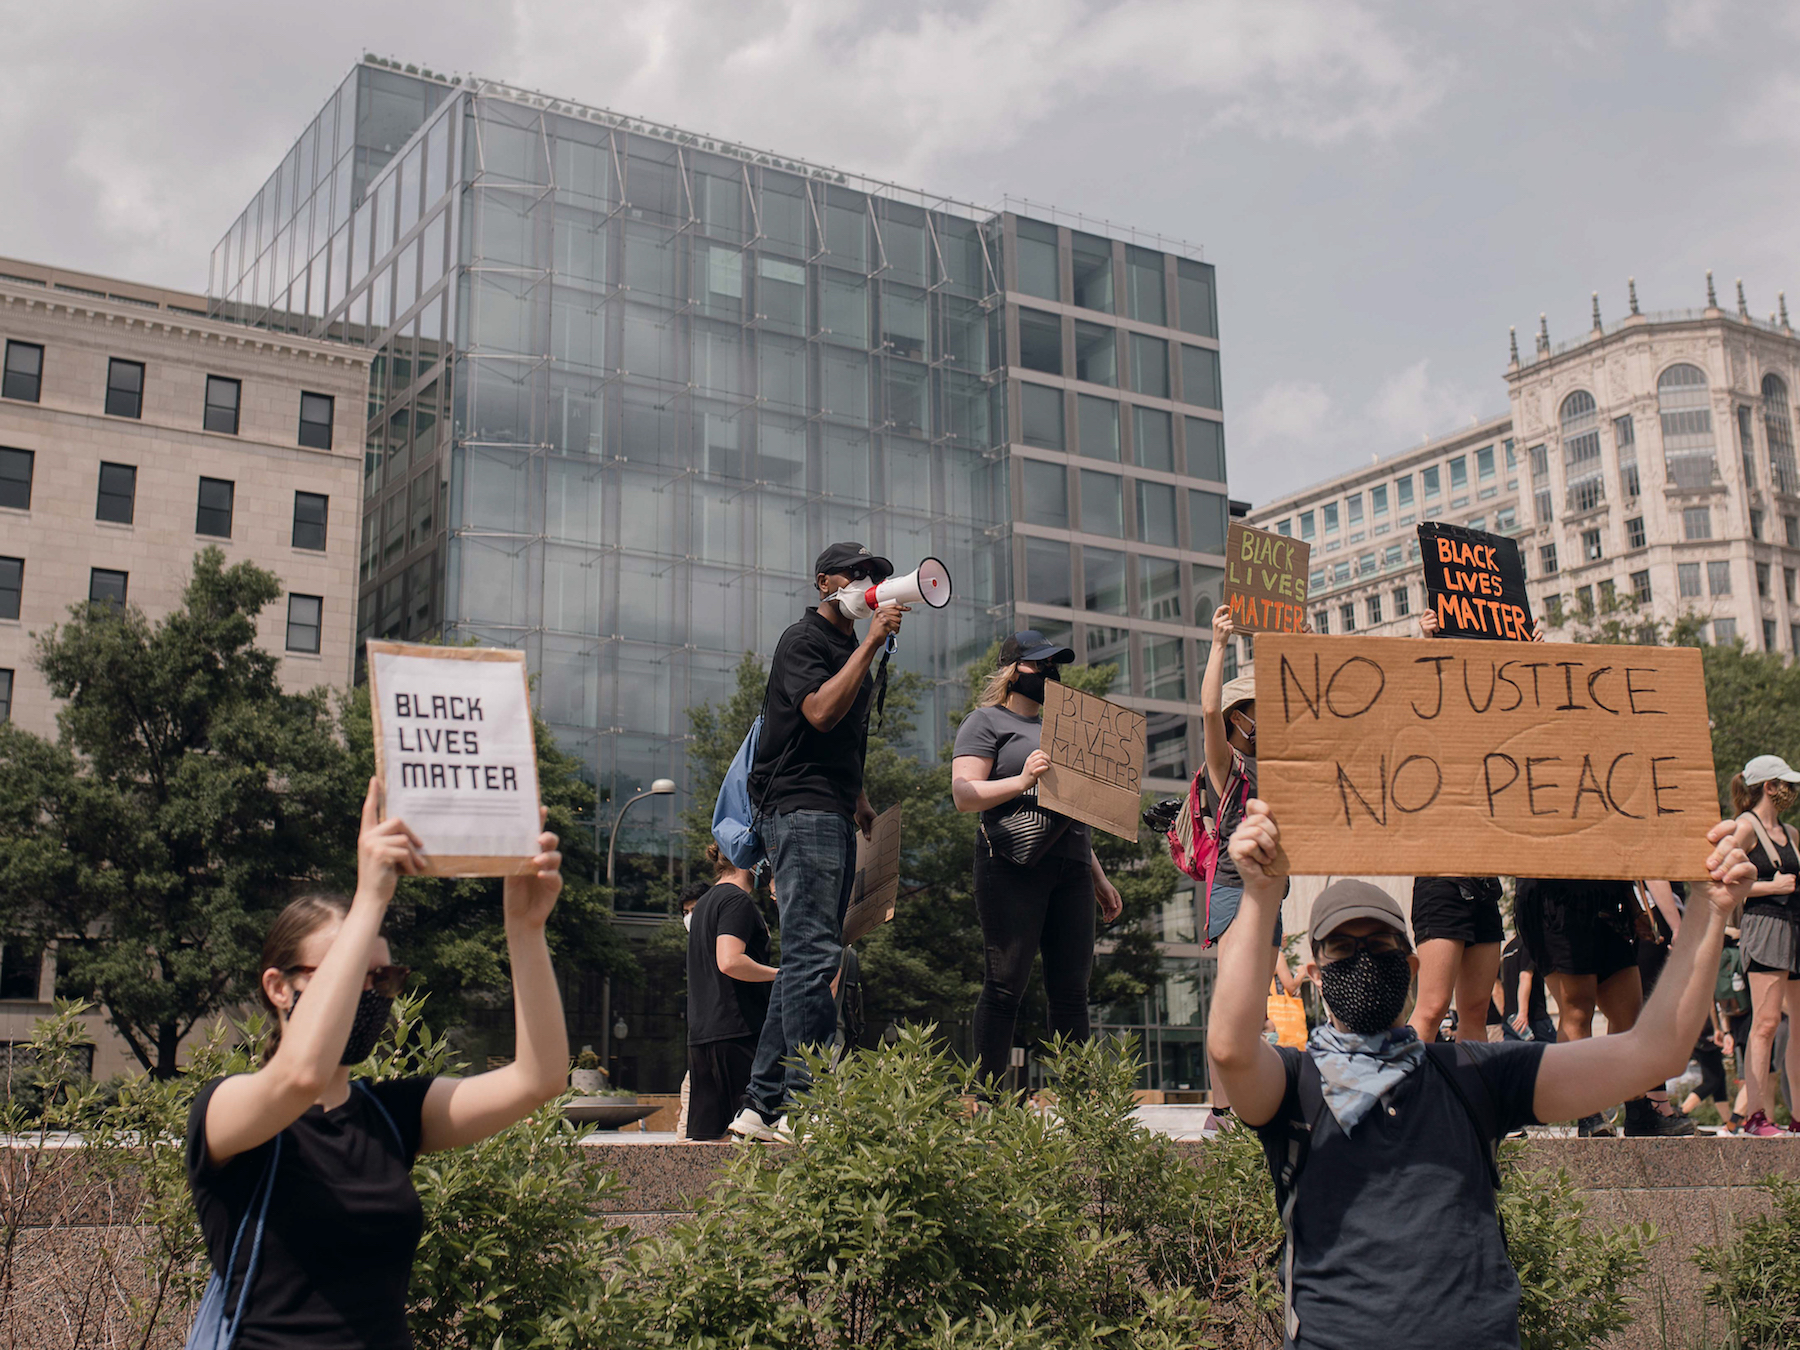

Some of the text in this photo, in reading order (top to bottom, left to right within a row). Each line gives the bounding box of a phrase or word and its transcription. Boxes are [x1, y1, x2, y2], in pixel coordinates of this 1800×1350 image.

[1241, 531, 1295, 571] BLACK
[1436, 538, 1499, 572] BLACK
[1229, 562, 1305, 602] LIVES
[1443, 567, 1502, 597] LIVES
[1229, 593, 1305, 633] MATTER
[1437, 594, 1533, 641] MATTER
[395, 693, 483, 721] BLACK
[1281, 653, 1668, 723] NO JUSTICE
[1061, 686, 1146, 747] BLACK
[398, 727, 479, 755] LIVES
[1054, 714, 1131, 766] LIVES
[402, 763, 517, 790] MATTER
[1051, 738, 1140, 795] MATTER
[1336, 752, 1685, 829] NO PEACE
